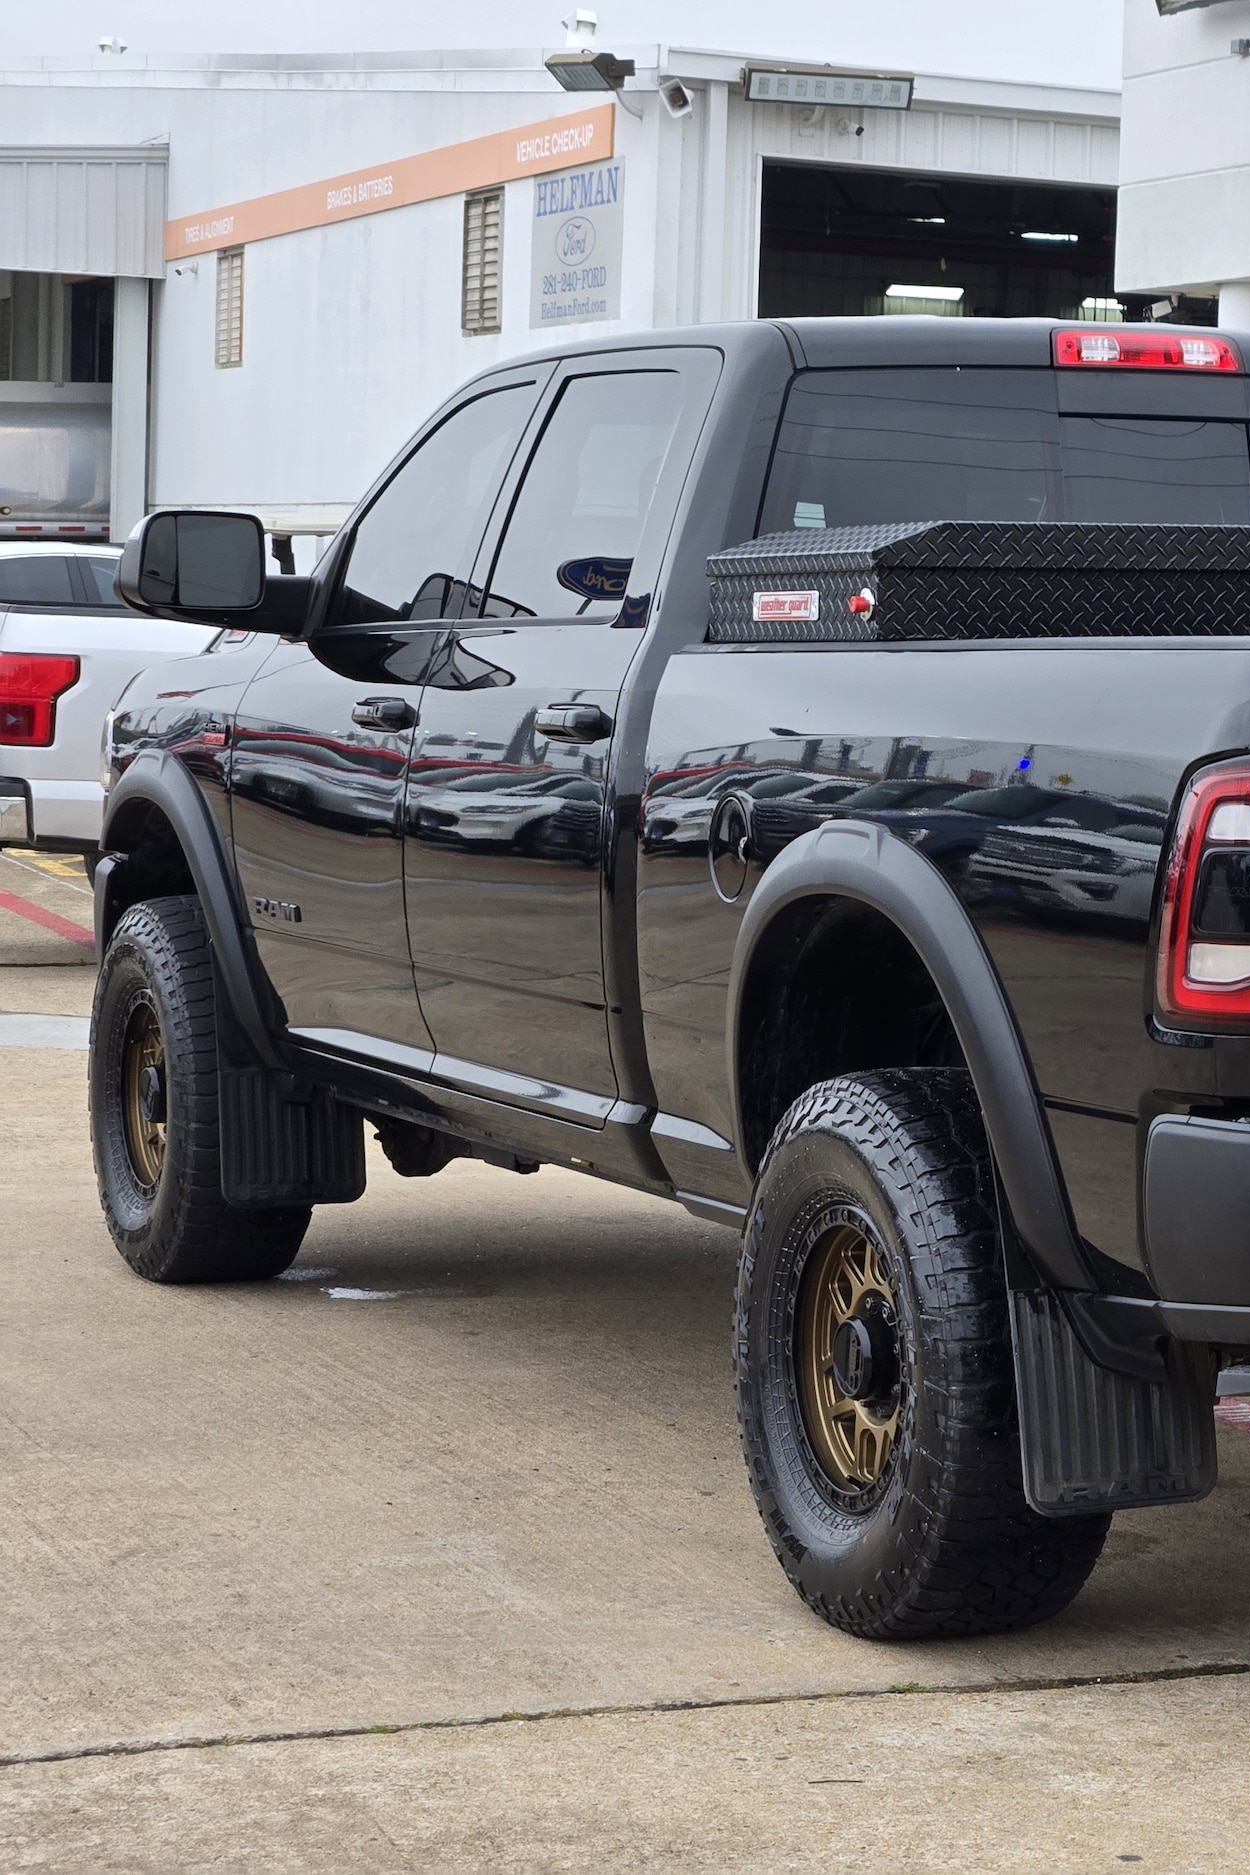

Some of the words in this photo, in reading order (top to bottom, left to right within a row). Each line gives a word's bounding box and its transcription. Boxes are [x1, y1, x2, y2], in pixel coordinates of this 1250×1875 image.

[516, 135, 550, 162] VEHICLE
[551, 123, 594, 154] CHECK-UP
[326, 186, 352, 210] BRAKES
[358, 175, 393, 201] BATTERIES
[536, 166, 620, 217] HELFMAN
[562, 223, 588, 257] Ford
[542, 266, 607, 295] 281-240-FORD
[541, 297, 607, 320] HelfmanFord.com
[760, 597, 787, 612] weather
[788, 596, 809, 613] guard
[252, 896, 302, 922] RAM
[1062, 1472, 1186, 1502] RAM
